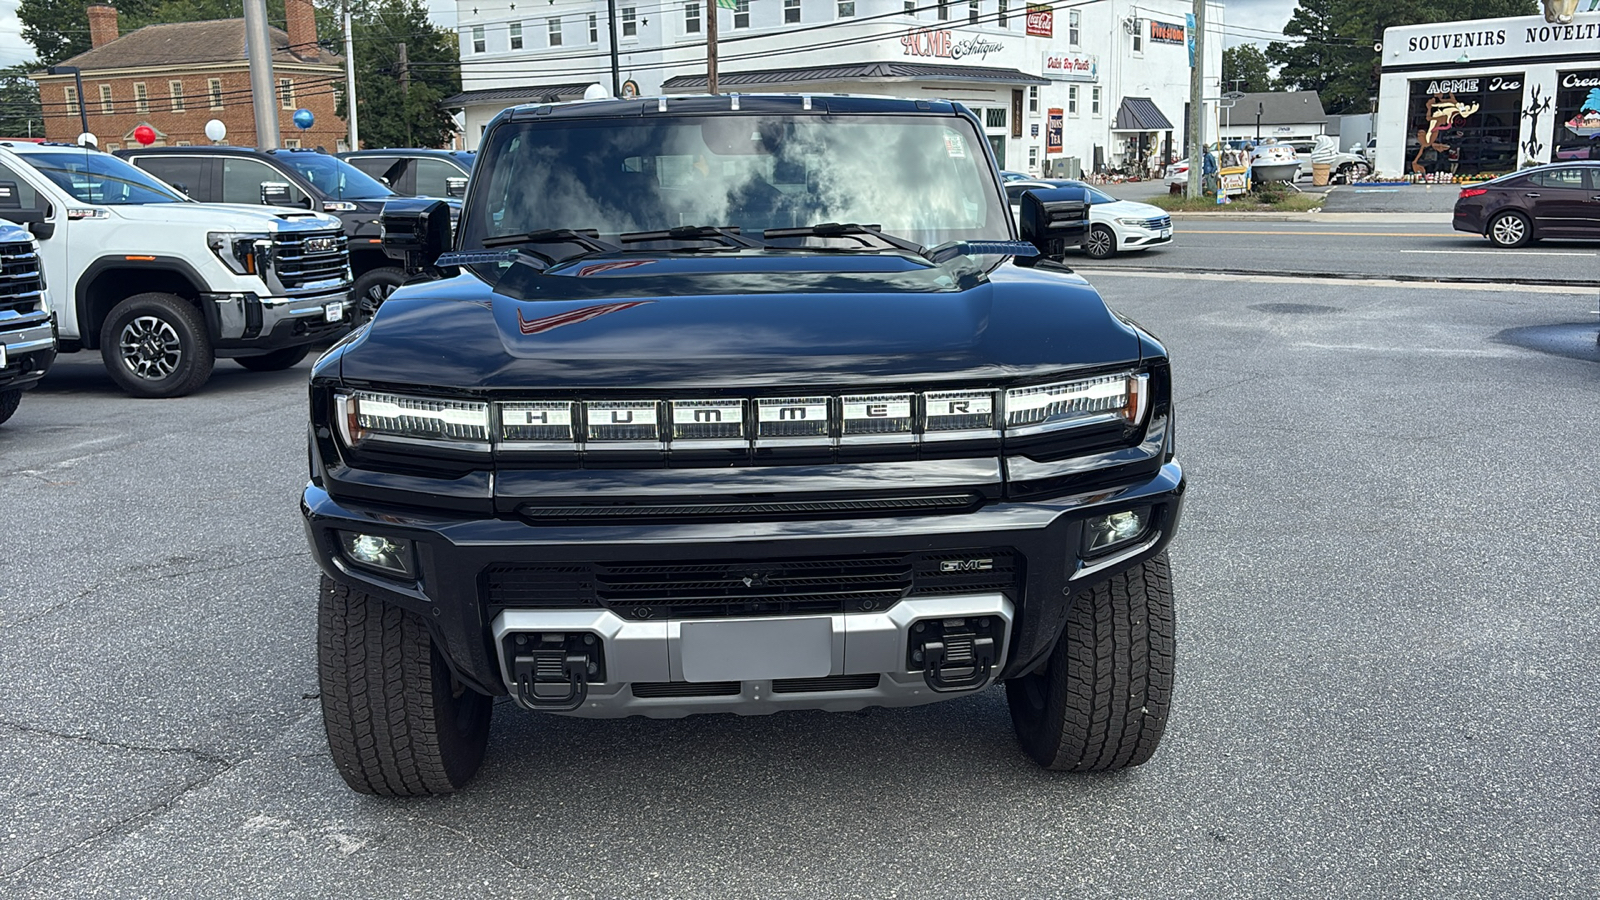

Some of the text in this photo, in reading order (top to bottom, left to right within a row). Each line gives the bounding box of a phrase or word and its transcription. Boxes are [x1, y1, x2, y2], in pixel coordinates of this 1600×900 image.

[900, 27, 1004, 61] ACME Antiques
[1408, 29, 1506, 52] SOUVENIRS
[1047, 56, 1090, 73] Dutch Boy Paints
[1426, 77, 1521, 94] ACME Ice
[1051, 133, 1061, 145] TEA
[940, 559, 993, 572] GMC
